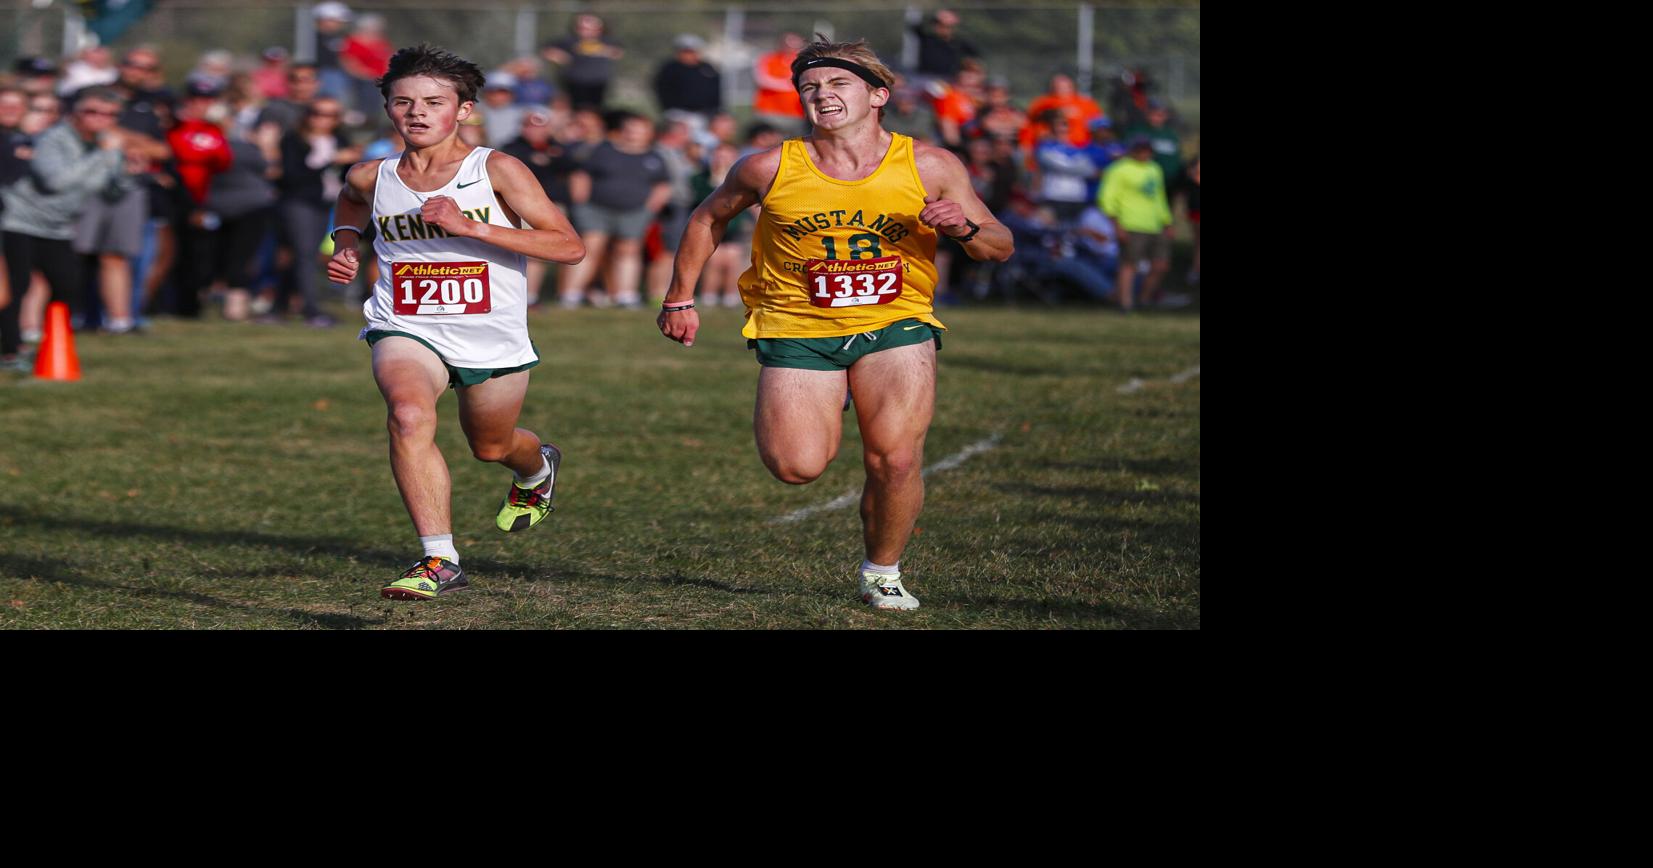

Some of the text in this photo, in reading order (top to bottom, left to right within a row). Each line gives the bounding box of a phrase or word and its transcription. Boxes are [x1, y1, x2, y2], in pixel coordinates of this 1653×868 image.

[782, 209, 909, 243] MUSTANGS
[821, 233, 882, 260] 18
[400, 278, 483, 304] 1200
[814, 272, 897, 298] 1332
